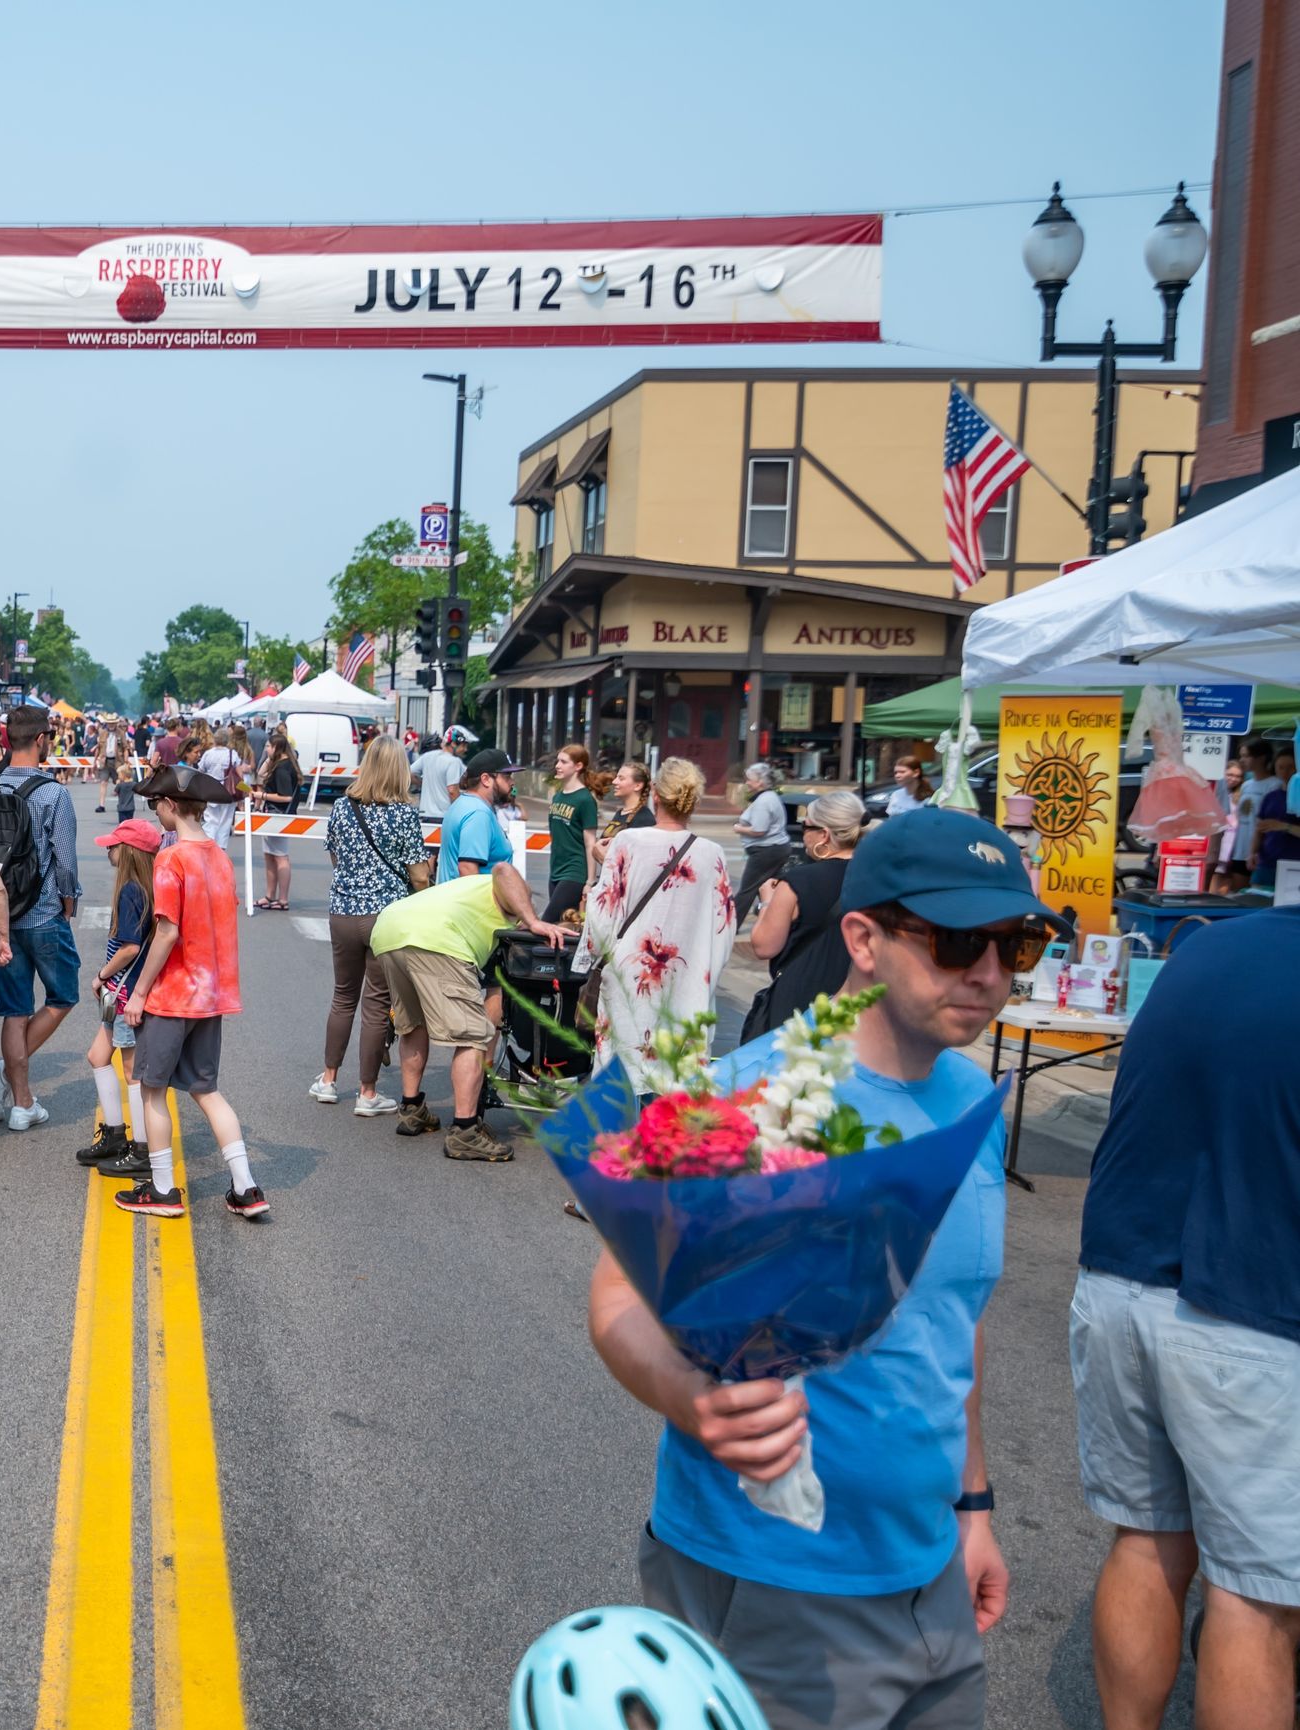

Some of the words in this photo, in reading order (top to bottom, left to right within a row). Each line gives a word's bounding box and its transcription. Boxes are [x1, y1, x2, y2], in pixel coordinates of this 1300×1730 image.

[125, 244, 143, 256] THE
[146, 241, 204, 257] HOPKINS
[99, 258, 223, 282] RASPBERRY
[162, 282, 227, 297] FESTIVAL
[353, 266, 491, 314] JULY
[67, 329, 257, 349] www.raspberrycapital.com
[652, 621, 728, 644] BLAKE
[792, 623, 916, 649] ANTIQUES
[1207, 718, 1234, 729] 3572
